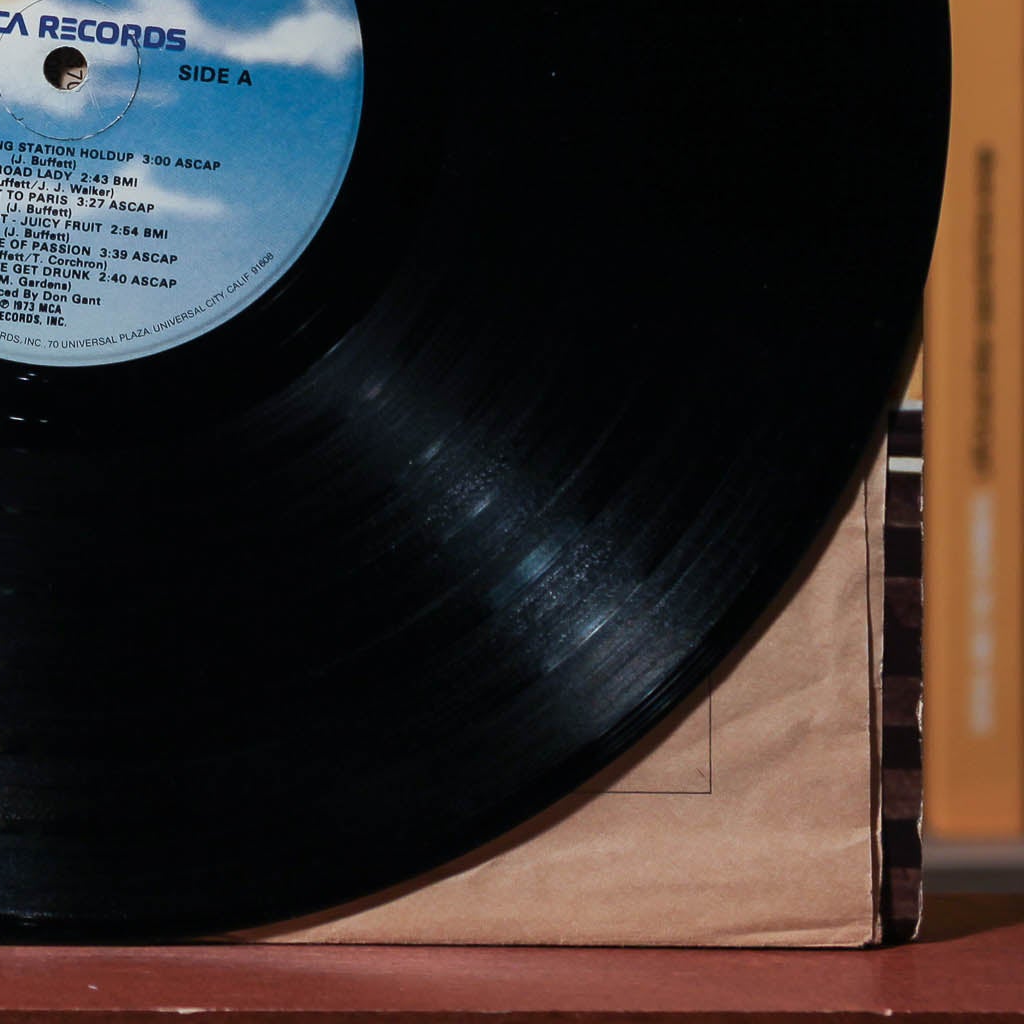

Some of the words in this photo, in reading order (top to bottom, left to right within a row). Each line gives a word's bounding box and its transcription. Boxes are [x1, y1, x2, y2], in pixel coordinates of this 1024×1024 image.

[38, 13, 187, 52] RECORDS
[179, 64, 229, 84] SIDE
[237, 70, 254, 87] A
[11, 154, 26, 165] (J.
[31, 155, 77, 170] Buffett)
[18, 142, 75, 156] STATION
[80, 148, 134, 163] HOLDUP
[142, 154, 171, 167] 3:00
[175, 158, 221, 171] ASCAP
[37, 168, 72, 181] LADY
[80, 172, 108, 185] 2:43
[113, 175, 138, 188] BMI
[54, 182, 65, 192] J.
[70, 183, 114, 198] Walker)
[6, 202, 21, 213] (J.
[26, 204, 72, 219] Buffett)
[7, 189, 24, 201] TO
[28, 192, 68, 205] PARIS
[77, 196, 105, 209] 3:27
[109, 200, 155, 213] ASCAP
[4, 227, 19, 238] (J.
[24, 228, 70, 244] Buffett)
[20, 216, 61, 229] JUICY
[65, 221, 102, 233] FRUIT
[110, 225, 138, 237] 2:54
[143, 227, 168, 240] BMI
[10, 239, 27, 250] OF
[32, 241, 91, 256] PASSION
[99, 248, 127, 260] 3:39
[132, 251, 178, 265] ASCAP
[48, 255, 108, 271] Corchron)
[13, 263, 38, 275] GET
[42, 266, 90, 280] DRUNK
[98, 272, 127, 284] 2:40
[131, 275, 177, 289] ASCAP
[14, 300, 35, 312] 1973
[39, 303, 62, 314] MCA
[23, 288, 39, 301] By
[43, 290, 67, 302] Don
[72, 293, 101, 306] Gant
[46, 315, 67, 327] INC.
[48, 340, 59, 349] 70
[61, 335, 117, 349] UNIVERSAL
[152, 305, 206, 333] UNIVERSAL
